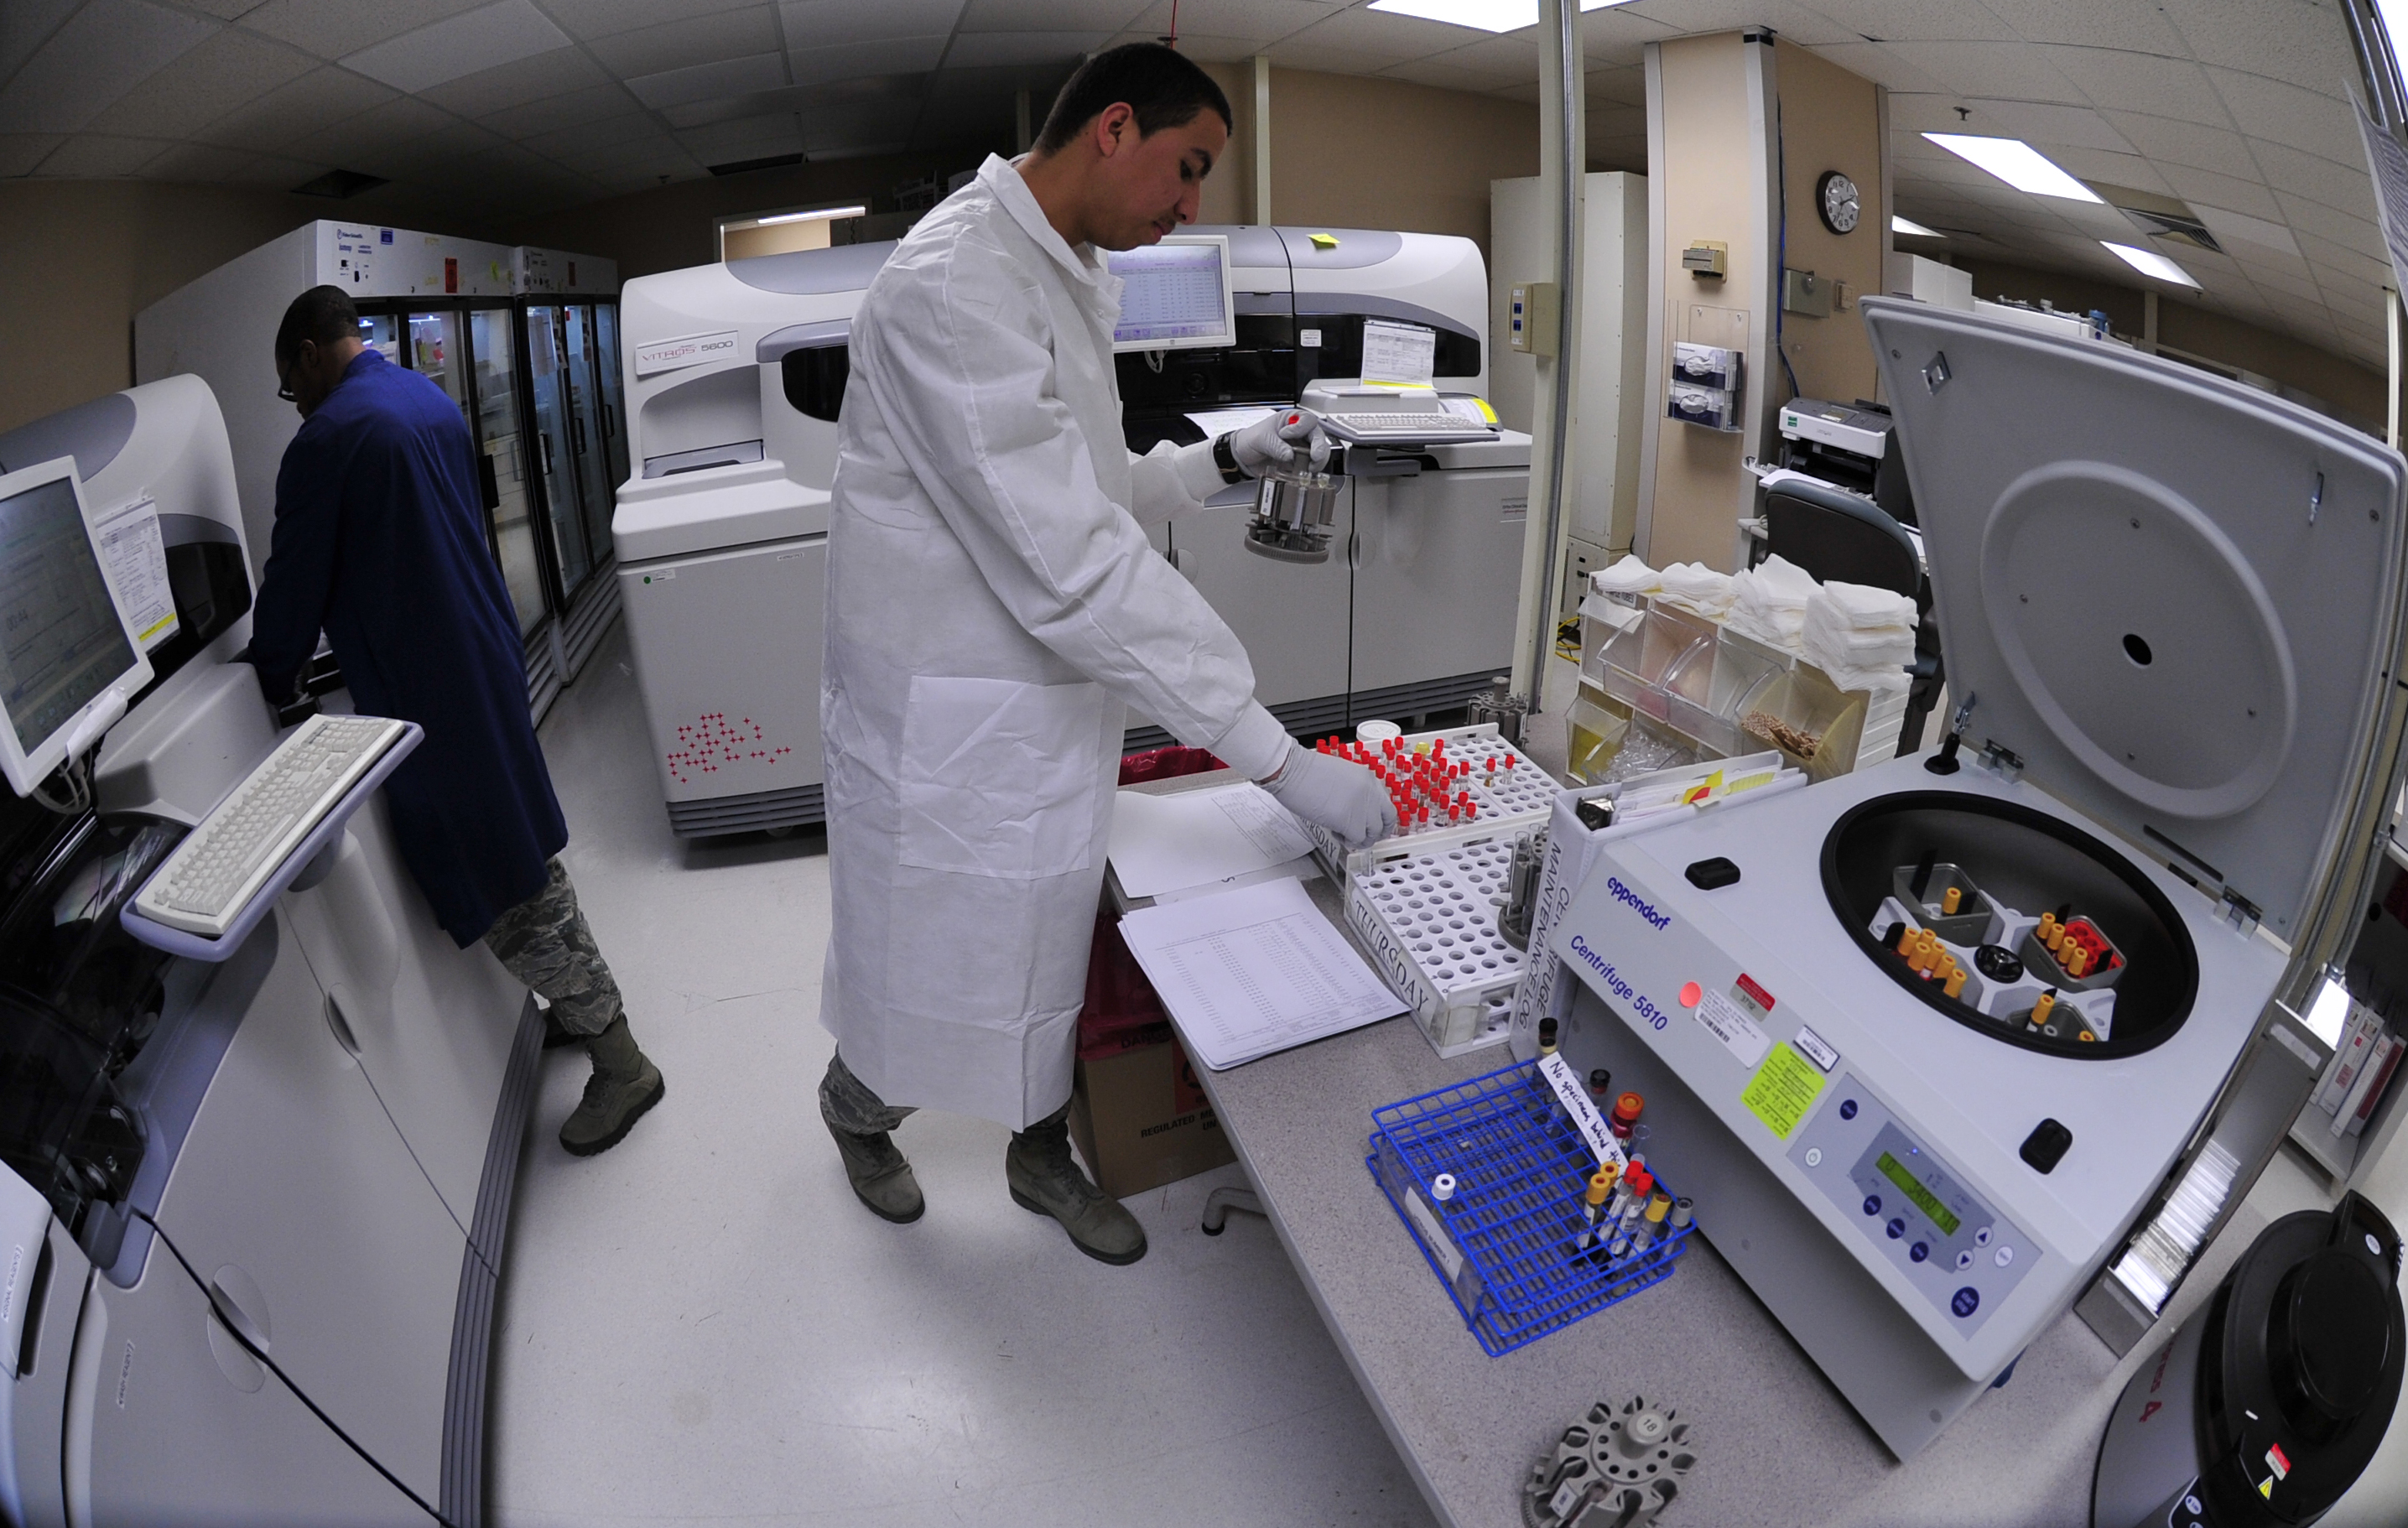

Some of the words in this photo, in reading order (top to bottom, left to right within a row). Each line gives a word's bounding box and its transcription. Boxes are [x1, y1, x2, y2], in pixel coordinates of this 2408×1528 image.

[642, 346, 696, 361] VITROS
[701, 340, 734, 352] 5600
[1527, 842, 1562, 991] MAINTENANCE
[1607, 876, 1672, 931] eppendorf
[1355, 900, 1429, 1012] THURSDAY
[1537, 886, 1570, 1018] CERIFUGE
[1519, 988, 1533, 1030] LOG
[1570, 935, 1634, 1000] Centrifuge
[1633, 995, 1668, 1031] 5810
[1141, 1115, 1195, 1138] REGULATED
[1549, 1061, 1565, 1079] No
[1561, 1080, 1591, 1122] specimens
[1590, 1120, 1610, 1151] behind
[1643, 1418, 1658, 1432] 18
[2139, 1401, 2162, 1423] 4
